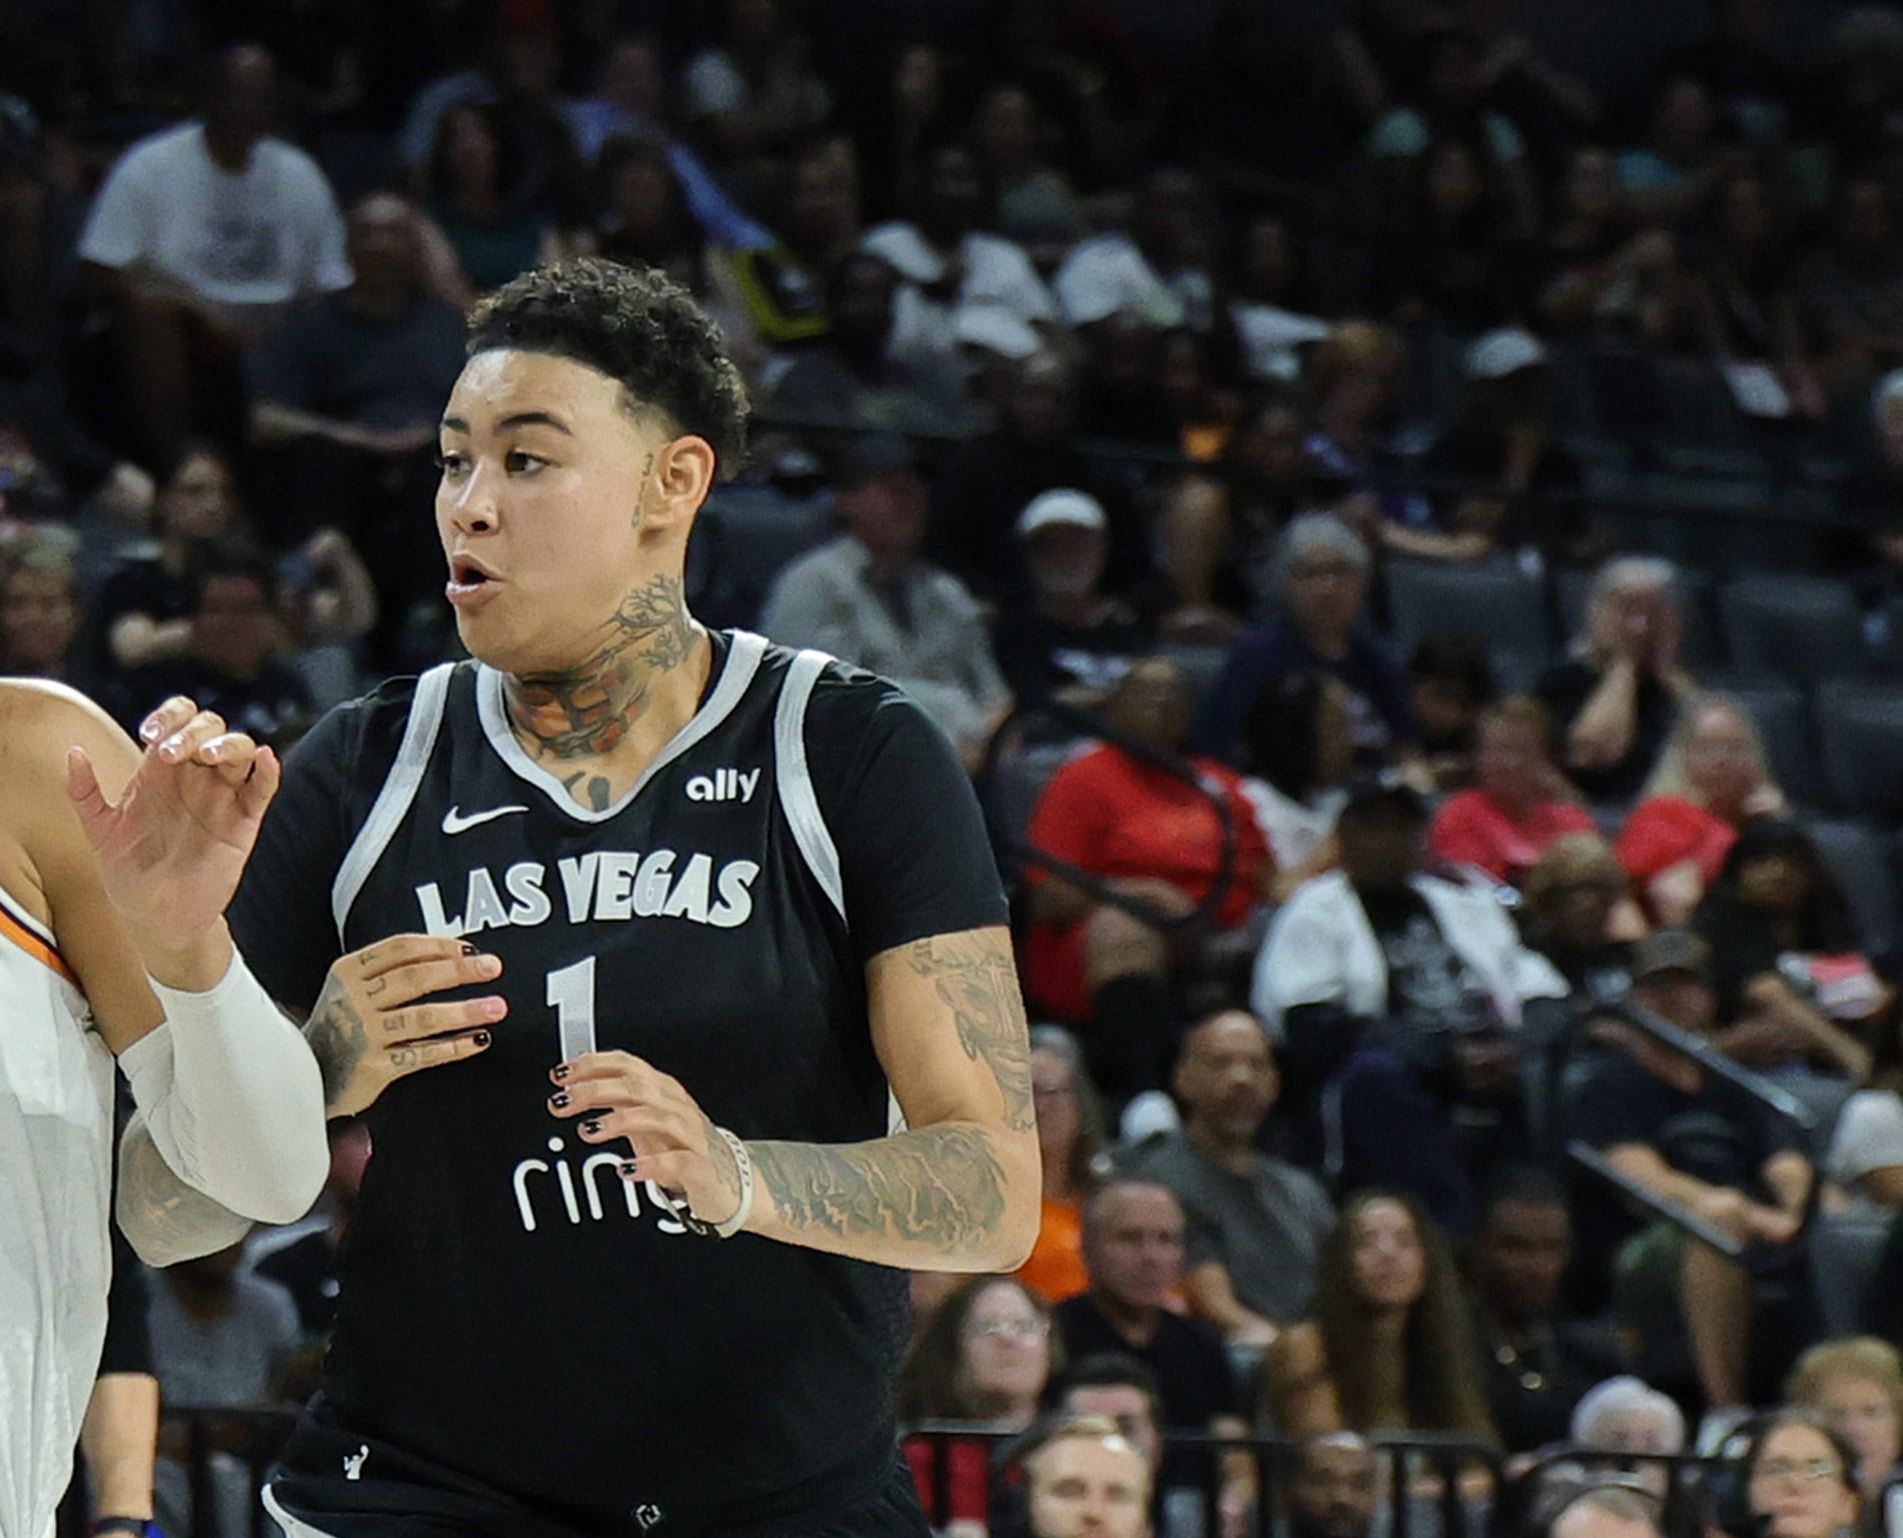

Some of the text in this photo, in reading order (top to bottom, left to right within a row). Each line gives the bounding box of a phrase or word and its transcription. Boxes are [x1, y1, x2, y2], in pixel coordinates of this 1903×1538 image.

[685, 767, 761, 803] ally
[415, 850, 761, 939] LAS VEGAS
[546, 955, 597, 1064] 1
